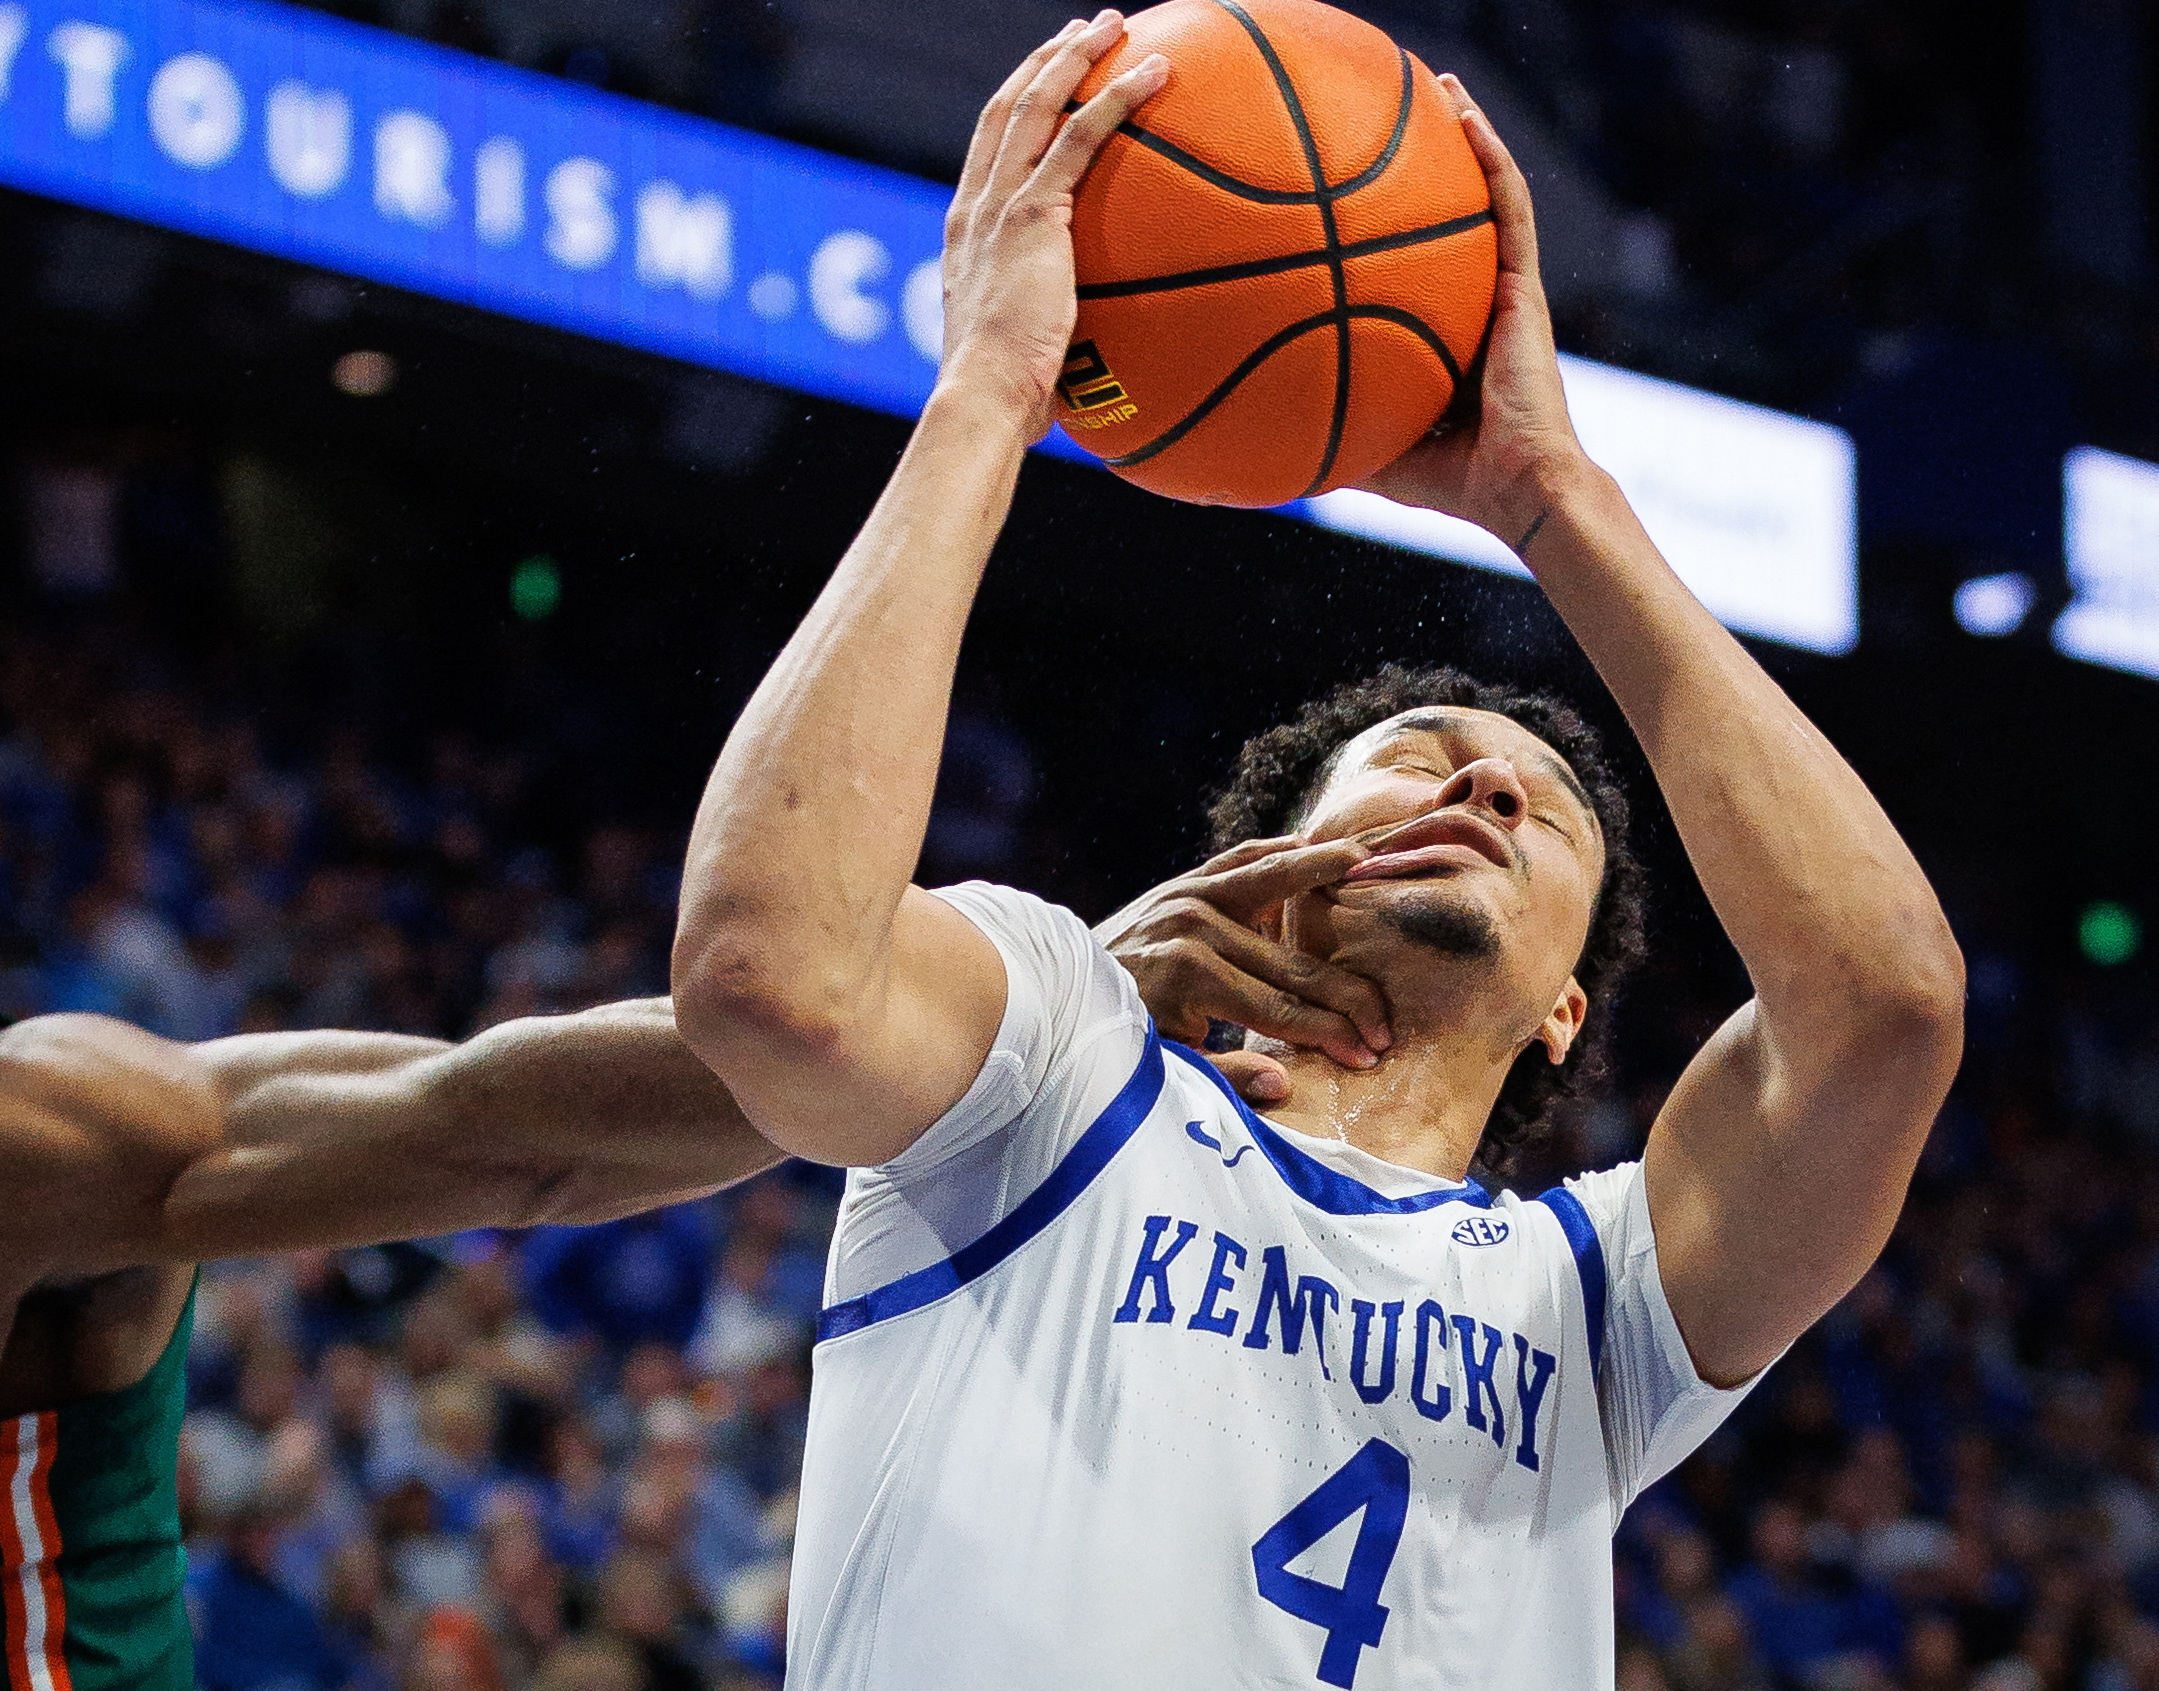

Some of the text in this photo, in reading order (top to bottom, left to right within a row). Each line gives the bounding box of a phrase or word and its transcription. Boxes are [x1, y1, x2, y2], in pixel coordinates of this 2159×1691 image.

[1113, 1215, 1556, 1472] KENTUCKY
[1452, 1218, 1508, 1245] SEC
[1252, 1437, 1411, 1690] 4
